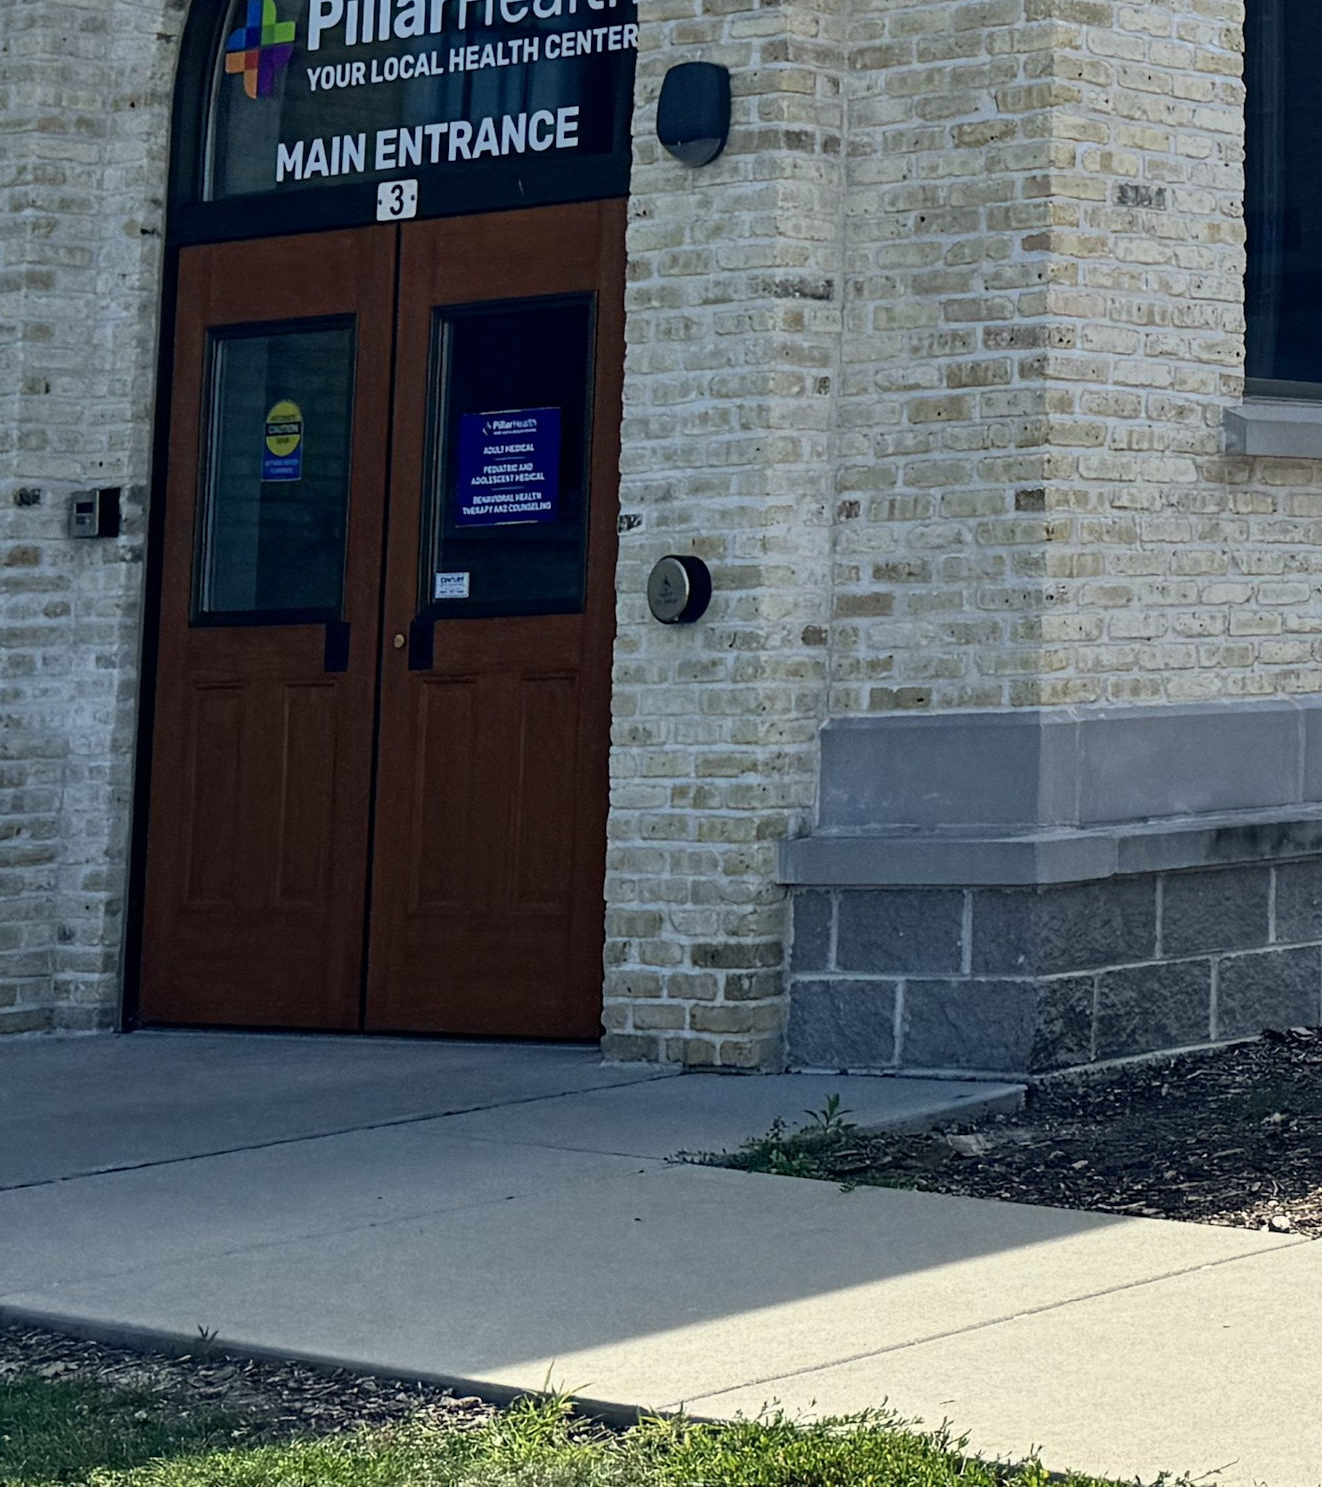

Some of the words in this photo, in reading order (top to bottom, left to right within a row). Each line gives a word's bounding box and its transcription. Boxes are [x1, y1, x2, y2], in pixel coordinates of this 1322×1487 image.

[306, 61, 366, 91] YOUR
[370, 51, 444, 83] LOCAL
[449, 37, 539, 73] HEALTH
[544, 23, 638, 59] CENTER
[275, 133, 366, 182] MAIN
[375, 106, 579, 170] ENTRANCE
[389, 184, 404, 216] 3
